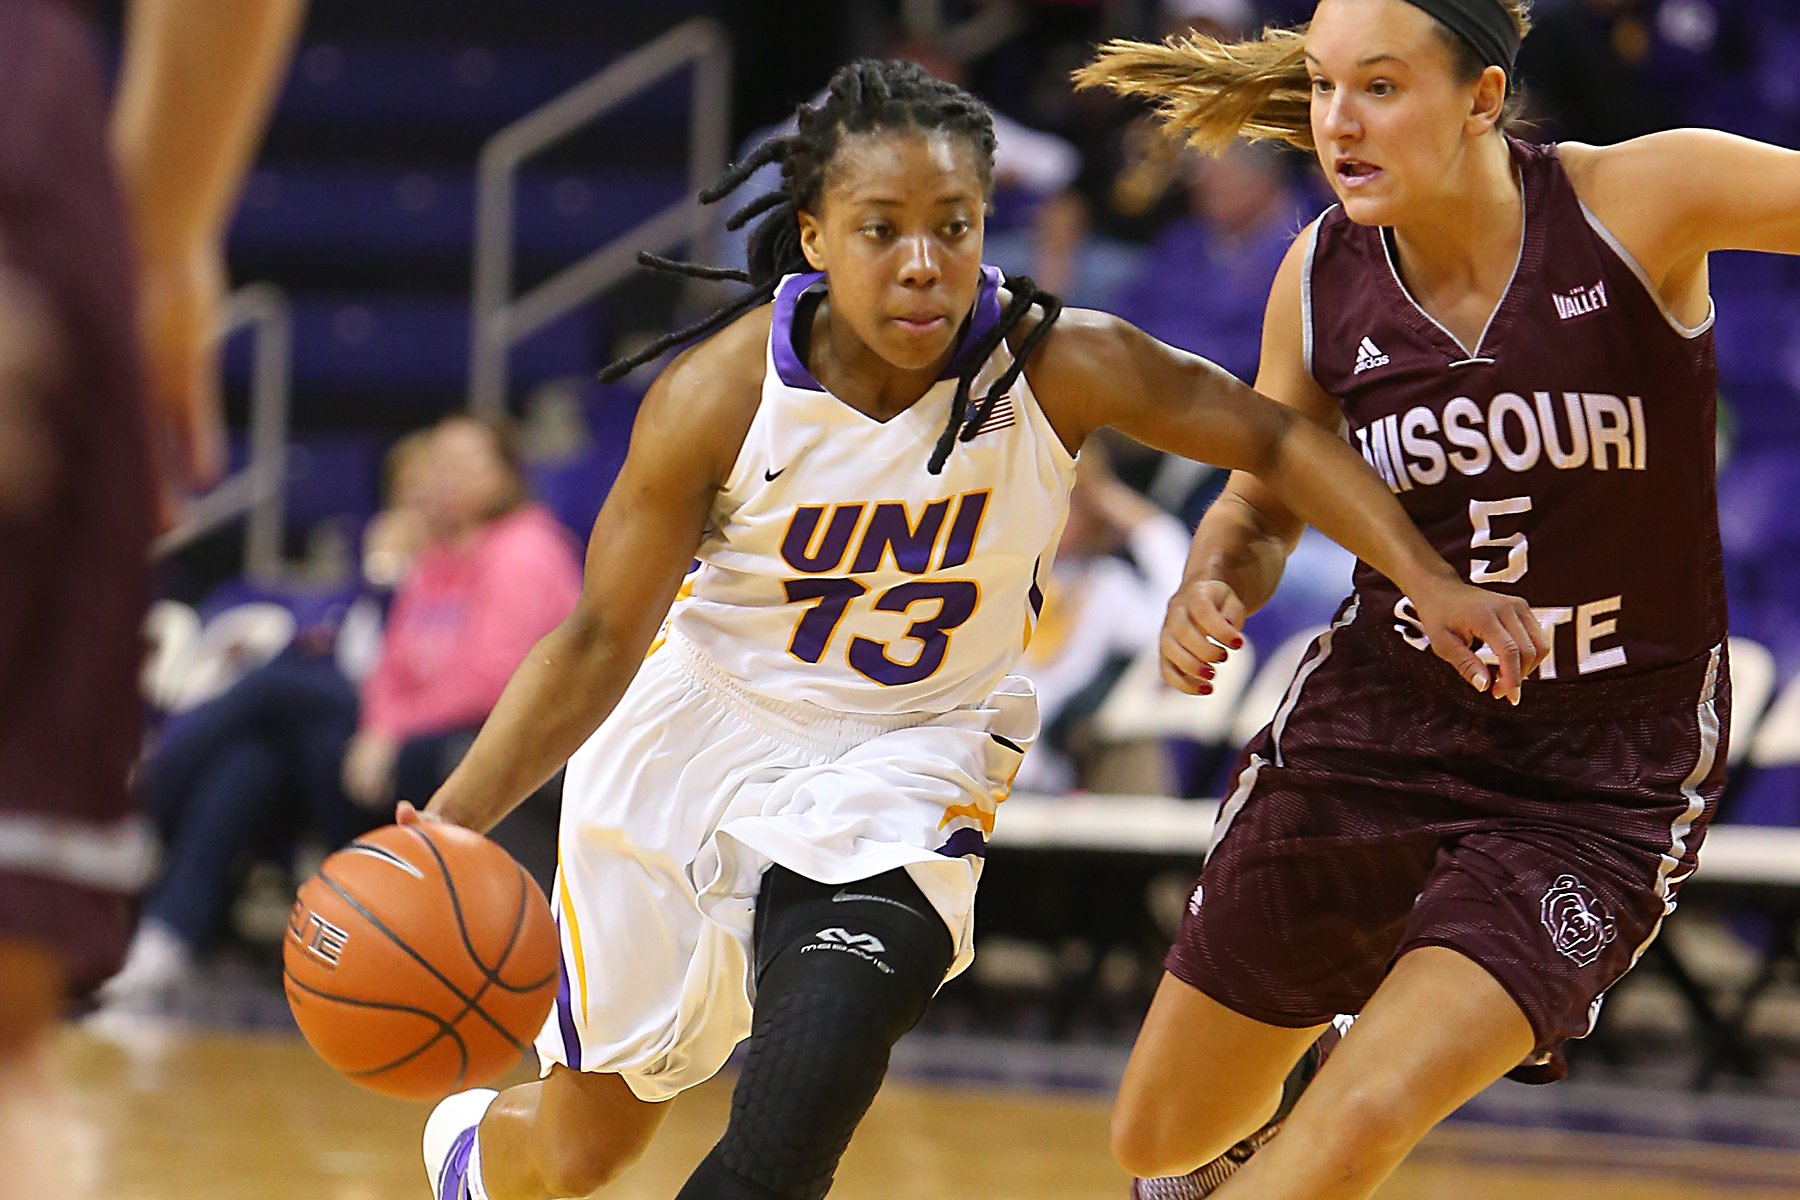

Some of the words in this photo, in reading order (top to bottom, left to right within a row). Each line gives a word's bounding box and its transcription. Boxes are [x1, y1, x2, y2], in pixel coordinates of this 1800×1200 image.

[1551, 279, 1608, 320] VALLEY
[1355, 391, 1647, 494] MISSOURI
[778, 487, 994, 574] UNI
[1469, 496, 1532, 584] 5
[779, 576, 982, 687] 13
[1394, 595, 1628, 680] STE
